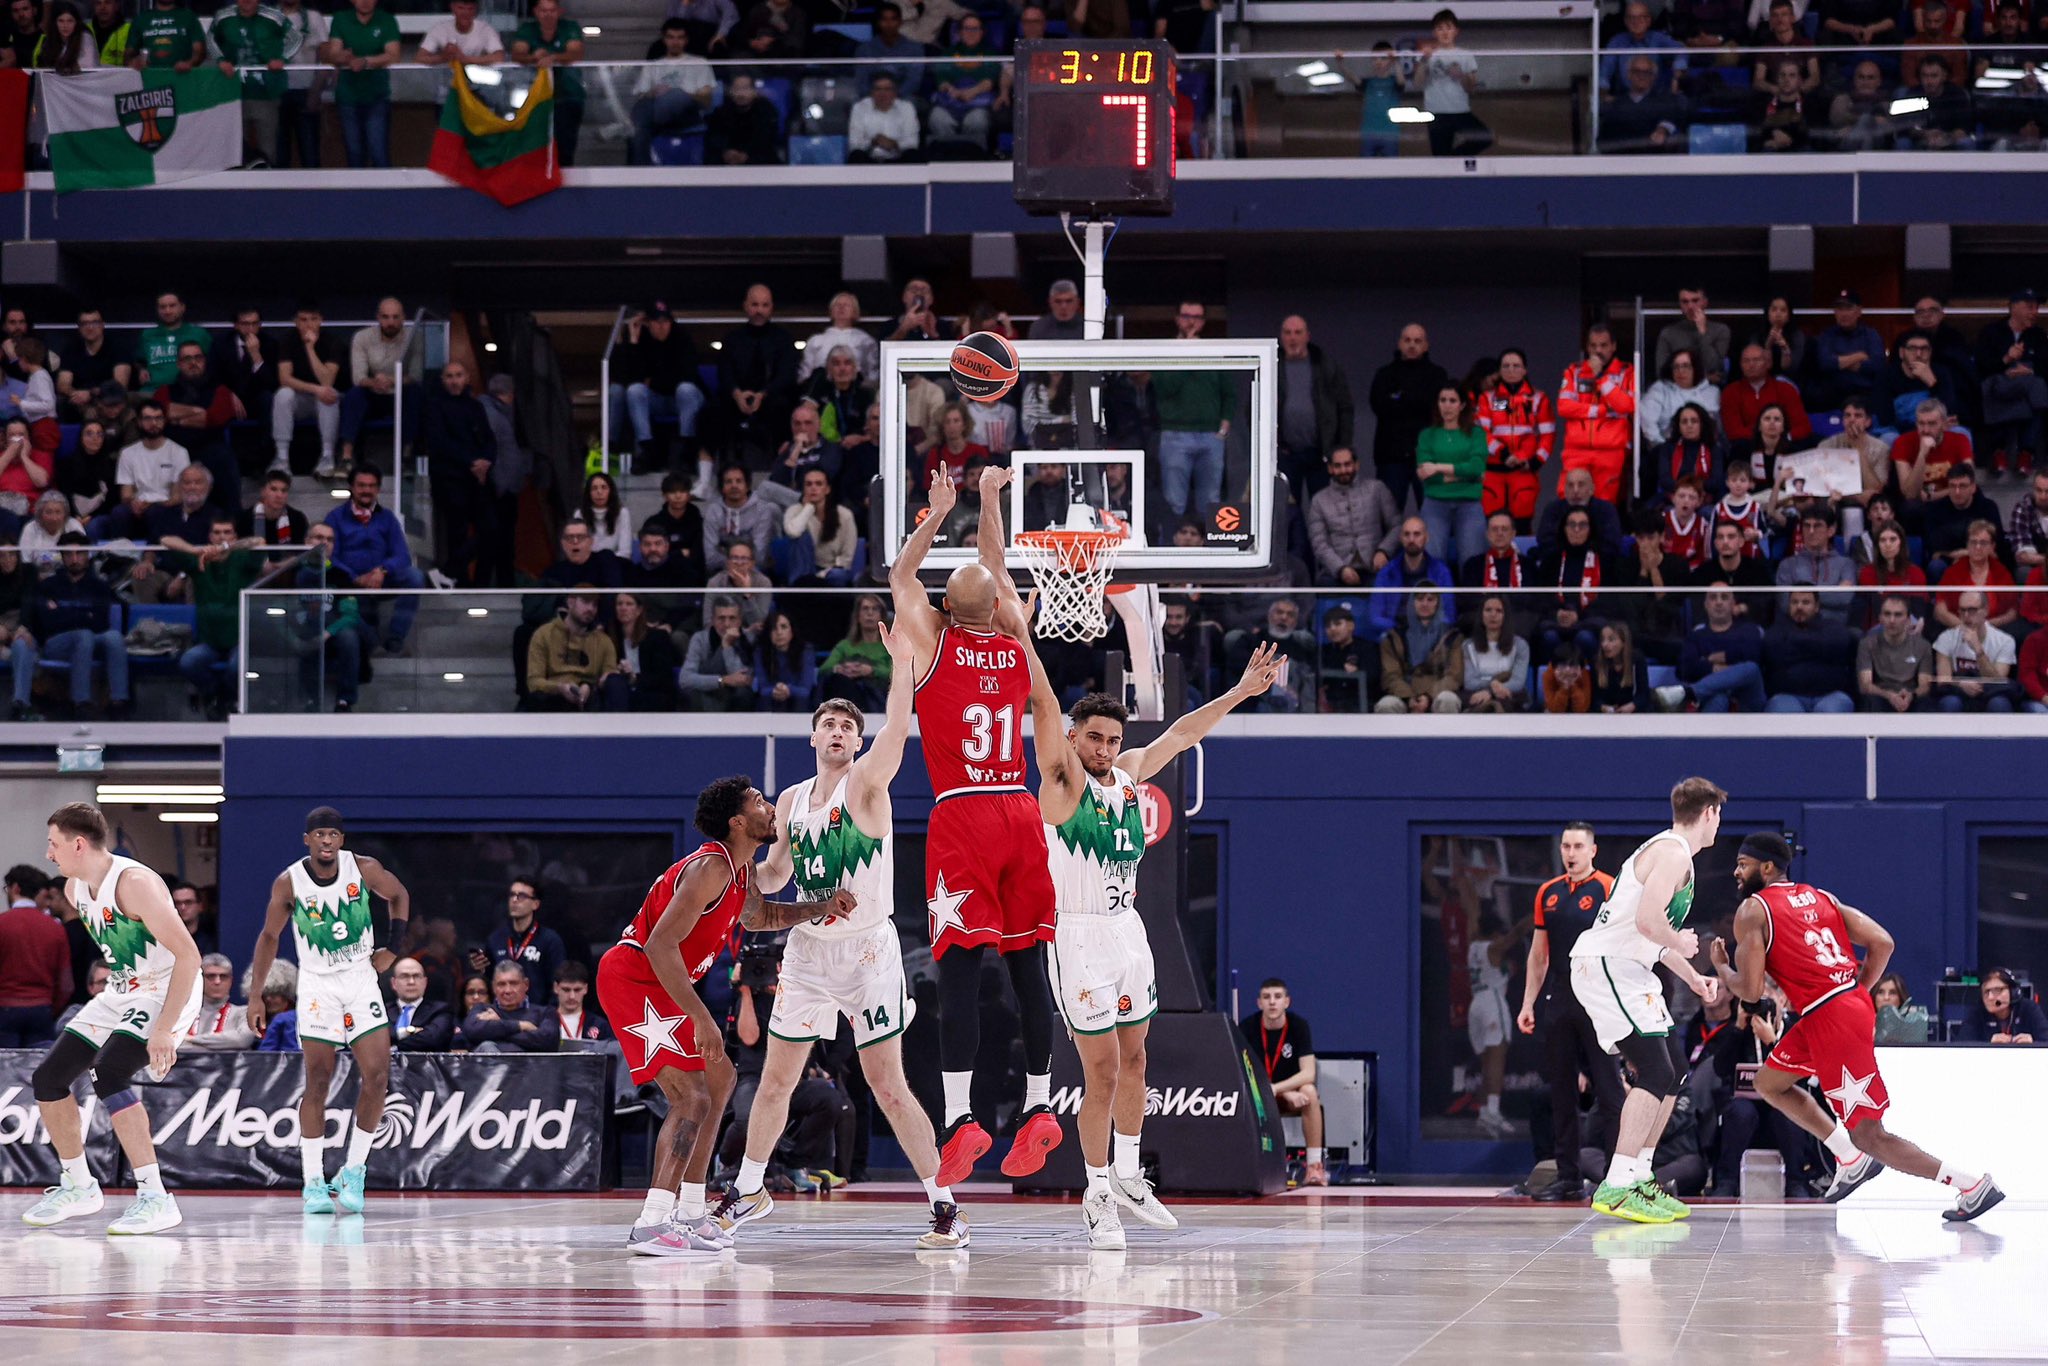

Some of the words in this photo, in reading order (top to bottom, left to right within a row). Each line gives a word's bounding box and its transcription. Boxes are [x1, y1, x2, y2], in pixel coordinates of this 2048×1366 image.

[1060, 50, 1153, 84] 3:10
[1103, 95, 1147, 166] 7
[961, 702, 1014, 762] 31
[1113, 828, 1134, 852] 12
[803, 854, 826, 881] 14
[1786, 890, 1817, 909] NEBO
[331, 920, 349, 941] 3
[1804, 926, 1850, 968] 32
[120, 1007, 151, 1030] 92
[369, 1001, 383, 1019] 3
[862, 1005, 890, 1031] 14
[1161, 1086, 1239, 1117] World
[153, 1087, 353, 1148] Meda
[410, 1090, 577, 1150] World
